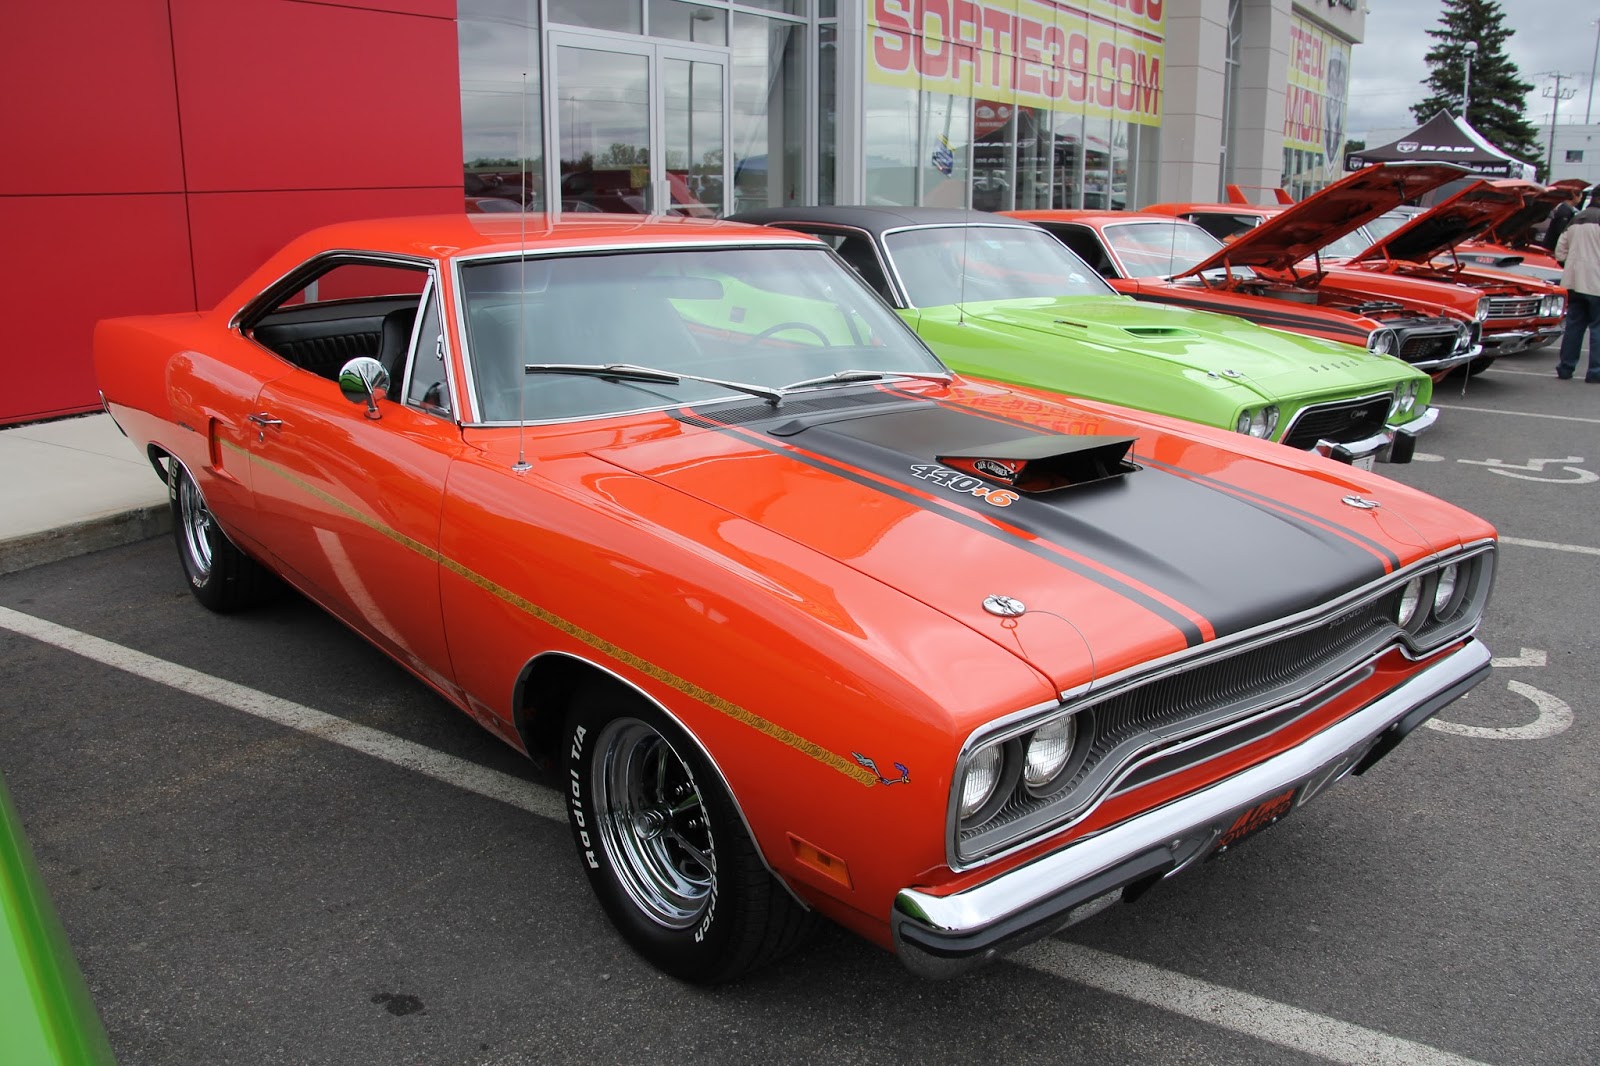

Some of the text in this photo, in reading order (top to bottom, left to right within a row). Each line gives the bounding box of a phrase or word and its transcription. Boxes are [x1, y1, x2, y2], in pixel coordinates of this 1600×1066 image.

[874, 0, 1160, 116] SORTIE39.COM
[910, 464, 1020, 507] 440+6
[570, 725, 599, 868] Radial T/A
